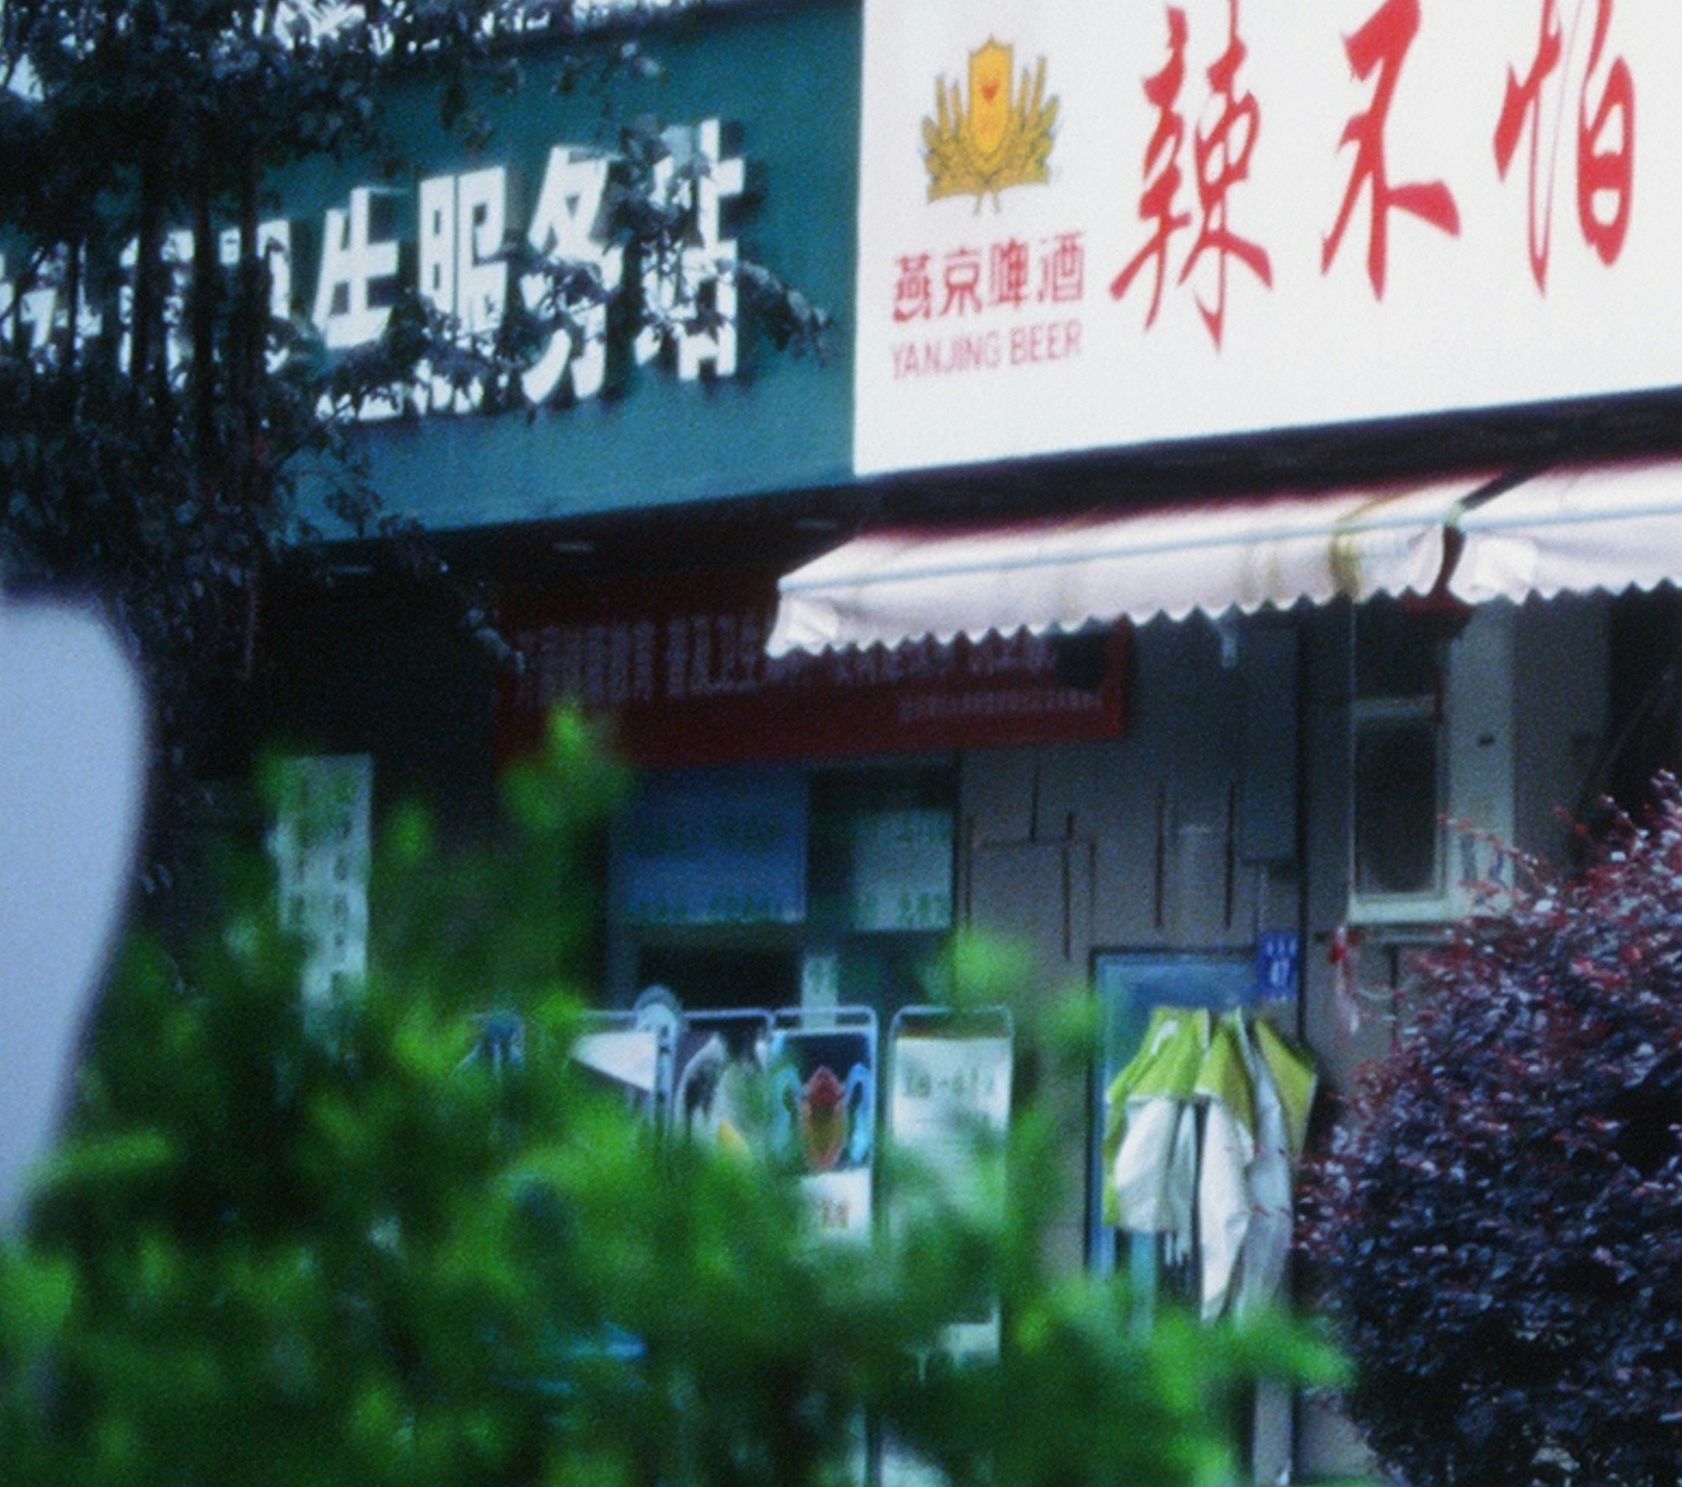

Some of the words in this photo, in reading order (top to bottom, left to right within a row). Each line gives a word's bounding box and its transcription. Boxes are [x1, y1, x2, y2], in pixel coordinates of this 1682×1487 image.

[0, 118, 745, 420] 生服务站
[892, 229, 1085, 323] 燕京啤酒
[891, 331, 1000, 379] YANJING
[1010, 319, 1082, 367] BEER
